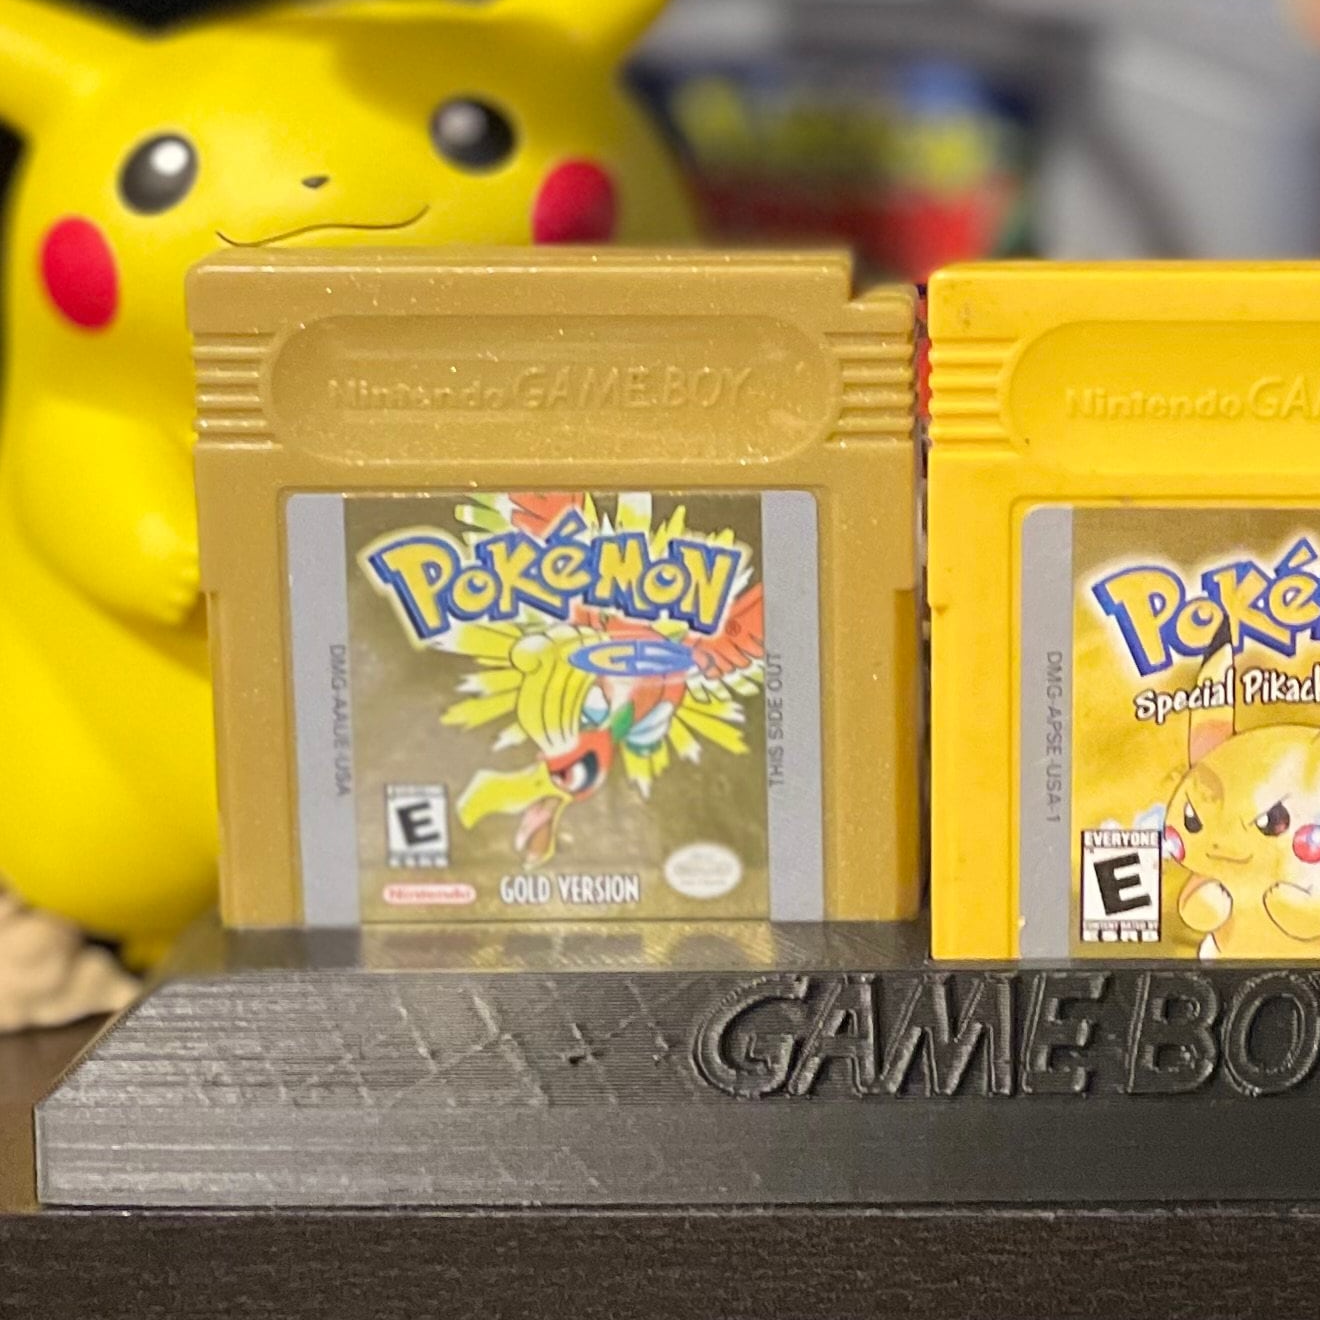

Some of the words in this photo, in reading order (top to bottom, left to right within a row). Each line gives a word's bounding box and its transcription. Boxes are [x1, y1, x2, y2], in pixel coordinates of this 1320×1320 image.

[512, 365, 652, 408] GAME
[661, 365, 752, 408] BOY
[1066, 386, 1244, 420] Nintendo
[767, 652, 783, 693] OUT
[1134, 665, 1235, 725] Special
[768, 696, 784, 740] SIDE
[769, 745, 784, 787] THIS
[396, 799, 442, 847] E
[1083, 830, 1161, 848] EVERYONE
[500, 875, 551, 905] GOLD
[557, 875, 642, 905] VERSION
[1093, 851, 1154, 916] E
[692, 971, 1112, 1099] GAME
